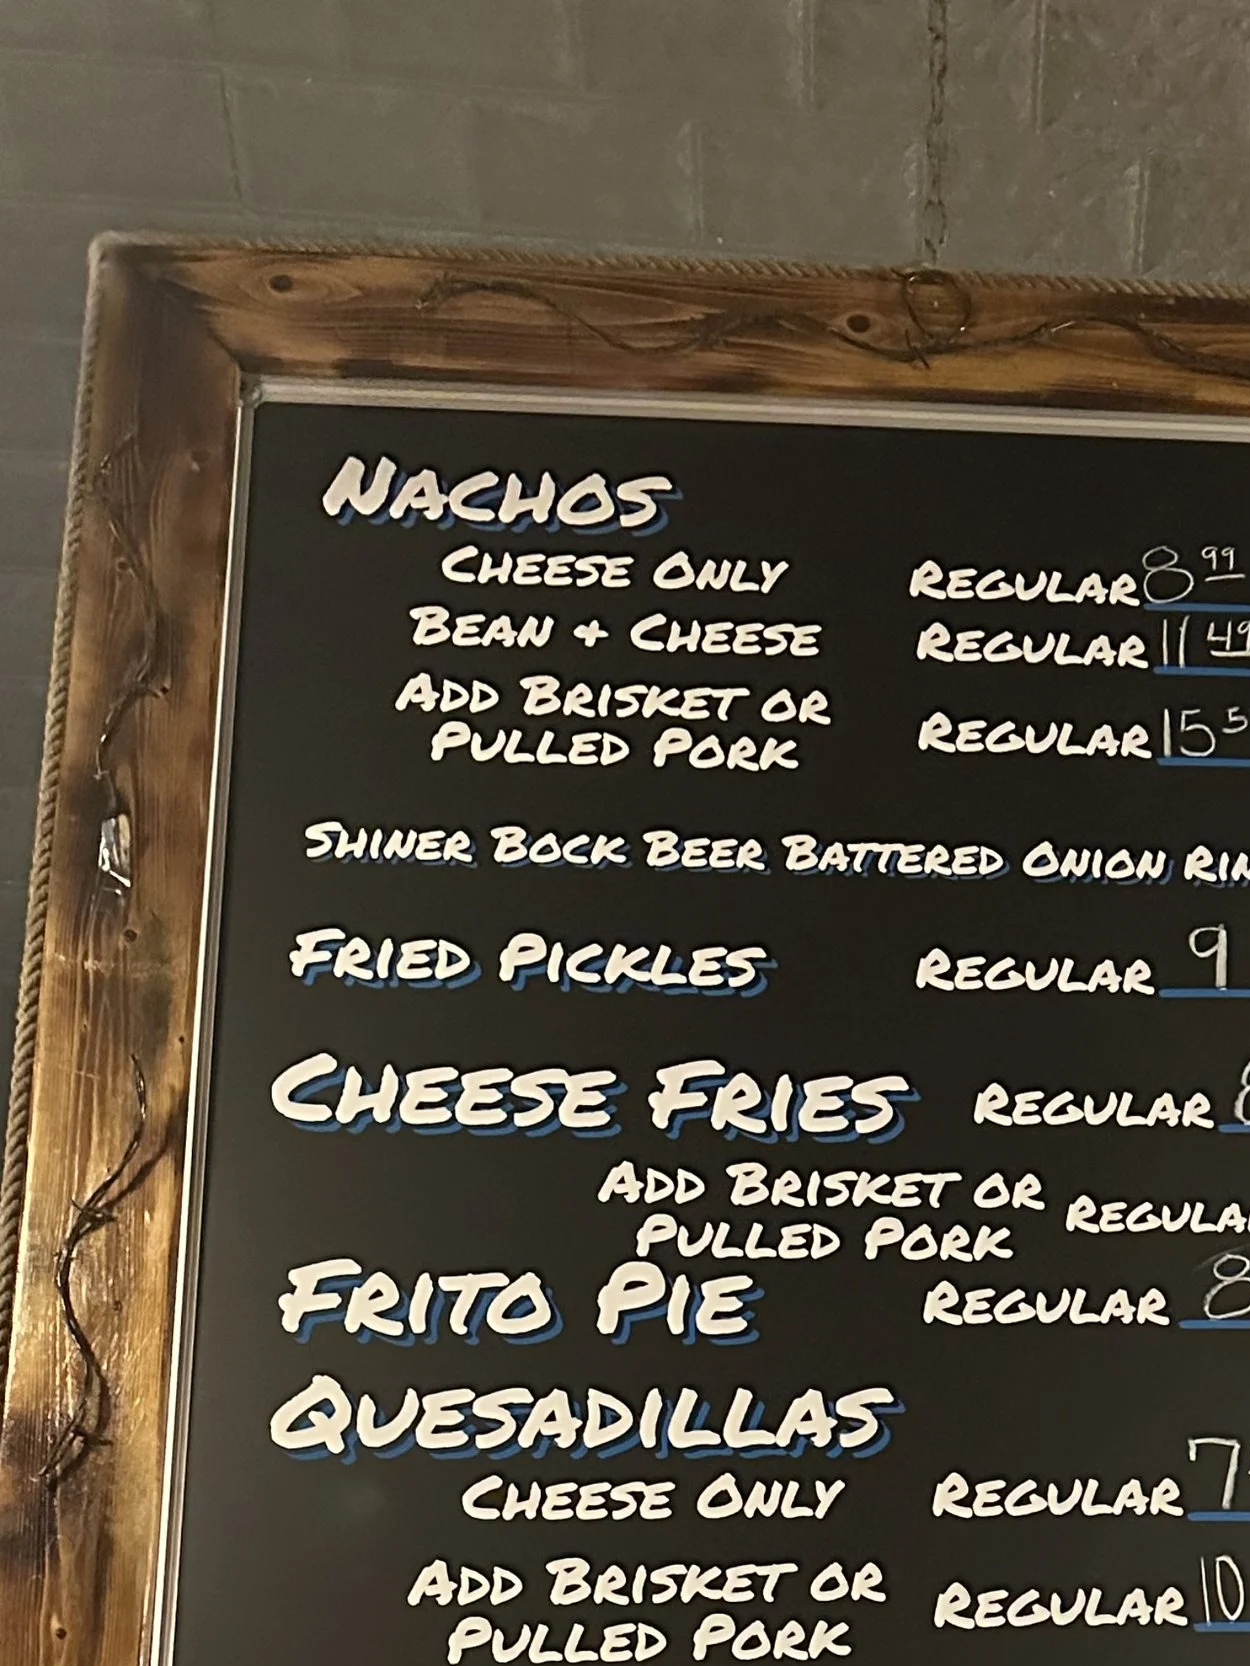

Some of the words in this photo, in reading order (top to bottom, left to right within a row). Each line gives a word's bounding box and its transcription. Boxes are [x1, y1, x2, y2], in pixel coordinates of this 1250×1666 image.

[323, 457, 672, 526] NACHOS
[442, 546, 634, 587] CHEESE
[653, 551, 788, 593] ONLY
[910, 560, 1140, 606] REGULAR
[410, 606, 554, 647] BEAN
[631, 614, 822, 656] CHEESE
[917, 622, 1148, 668] REGULAR
[395, 673, 499, 713] ADD
[520, 676, 750, 721] BRISKET
[761, 689, 830, 724] OR
[431, 721, 629, 765] PULLED
[654, 728, 798, 771] PORK
[918, 712, 1152, 758] REGULAR
[305, 822, 472, 862] SHINER
[491, 826, 626, 864] BOCK
[643, 831, 765, 870] BEER
[782, 835, 1003, 875] BATTERED
[1023, 841, 1166, 879] ONION
[290, 929, 470, 980] FRIED
[499, 933, 766, 987] PICKLES
[916, 948, 1154, 994] REGULAR
[1189, 924, 1227, 987] 9
[272, 1053, 616, 1127] CHEESE
[648, 1060, 909, 1133] FRIES
[974, 1083, 1214, 1128] REGULAR
[598, 1161, 705, 1204] ADD
[726, 1163, 962, 1208] BRISKET
[974, 1173, 1045, 1210] OR
[636, 1214, 840, 1259] PULLED
[865, 1217, 1013, 1262] PORK
[278, 1259, 551, 1335] FRITO
[597, 1262, 753, 1334] PIE
[923, 1281, 1169, 1325] REGULAR
[270, 1375, 894, 1453] QUESADILLAS
[462, 1475, 675, 1520] CHEESE
[697, 1473, 845, 1519] ONLY
[933, 1473, 1183, 1518] REGULAR
[408, 1560, 522, 1605] ADD
[546, 1558, 798, 1605] BRISKET
[811, 1562, 886, 1602] OR
[934, 1582, 1187, 1629] REGULAR
[448, 1617, 666, 1664] PULLED
[693, 1614, 851, 1660] PORK
